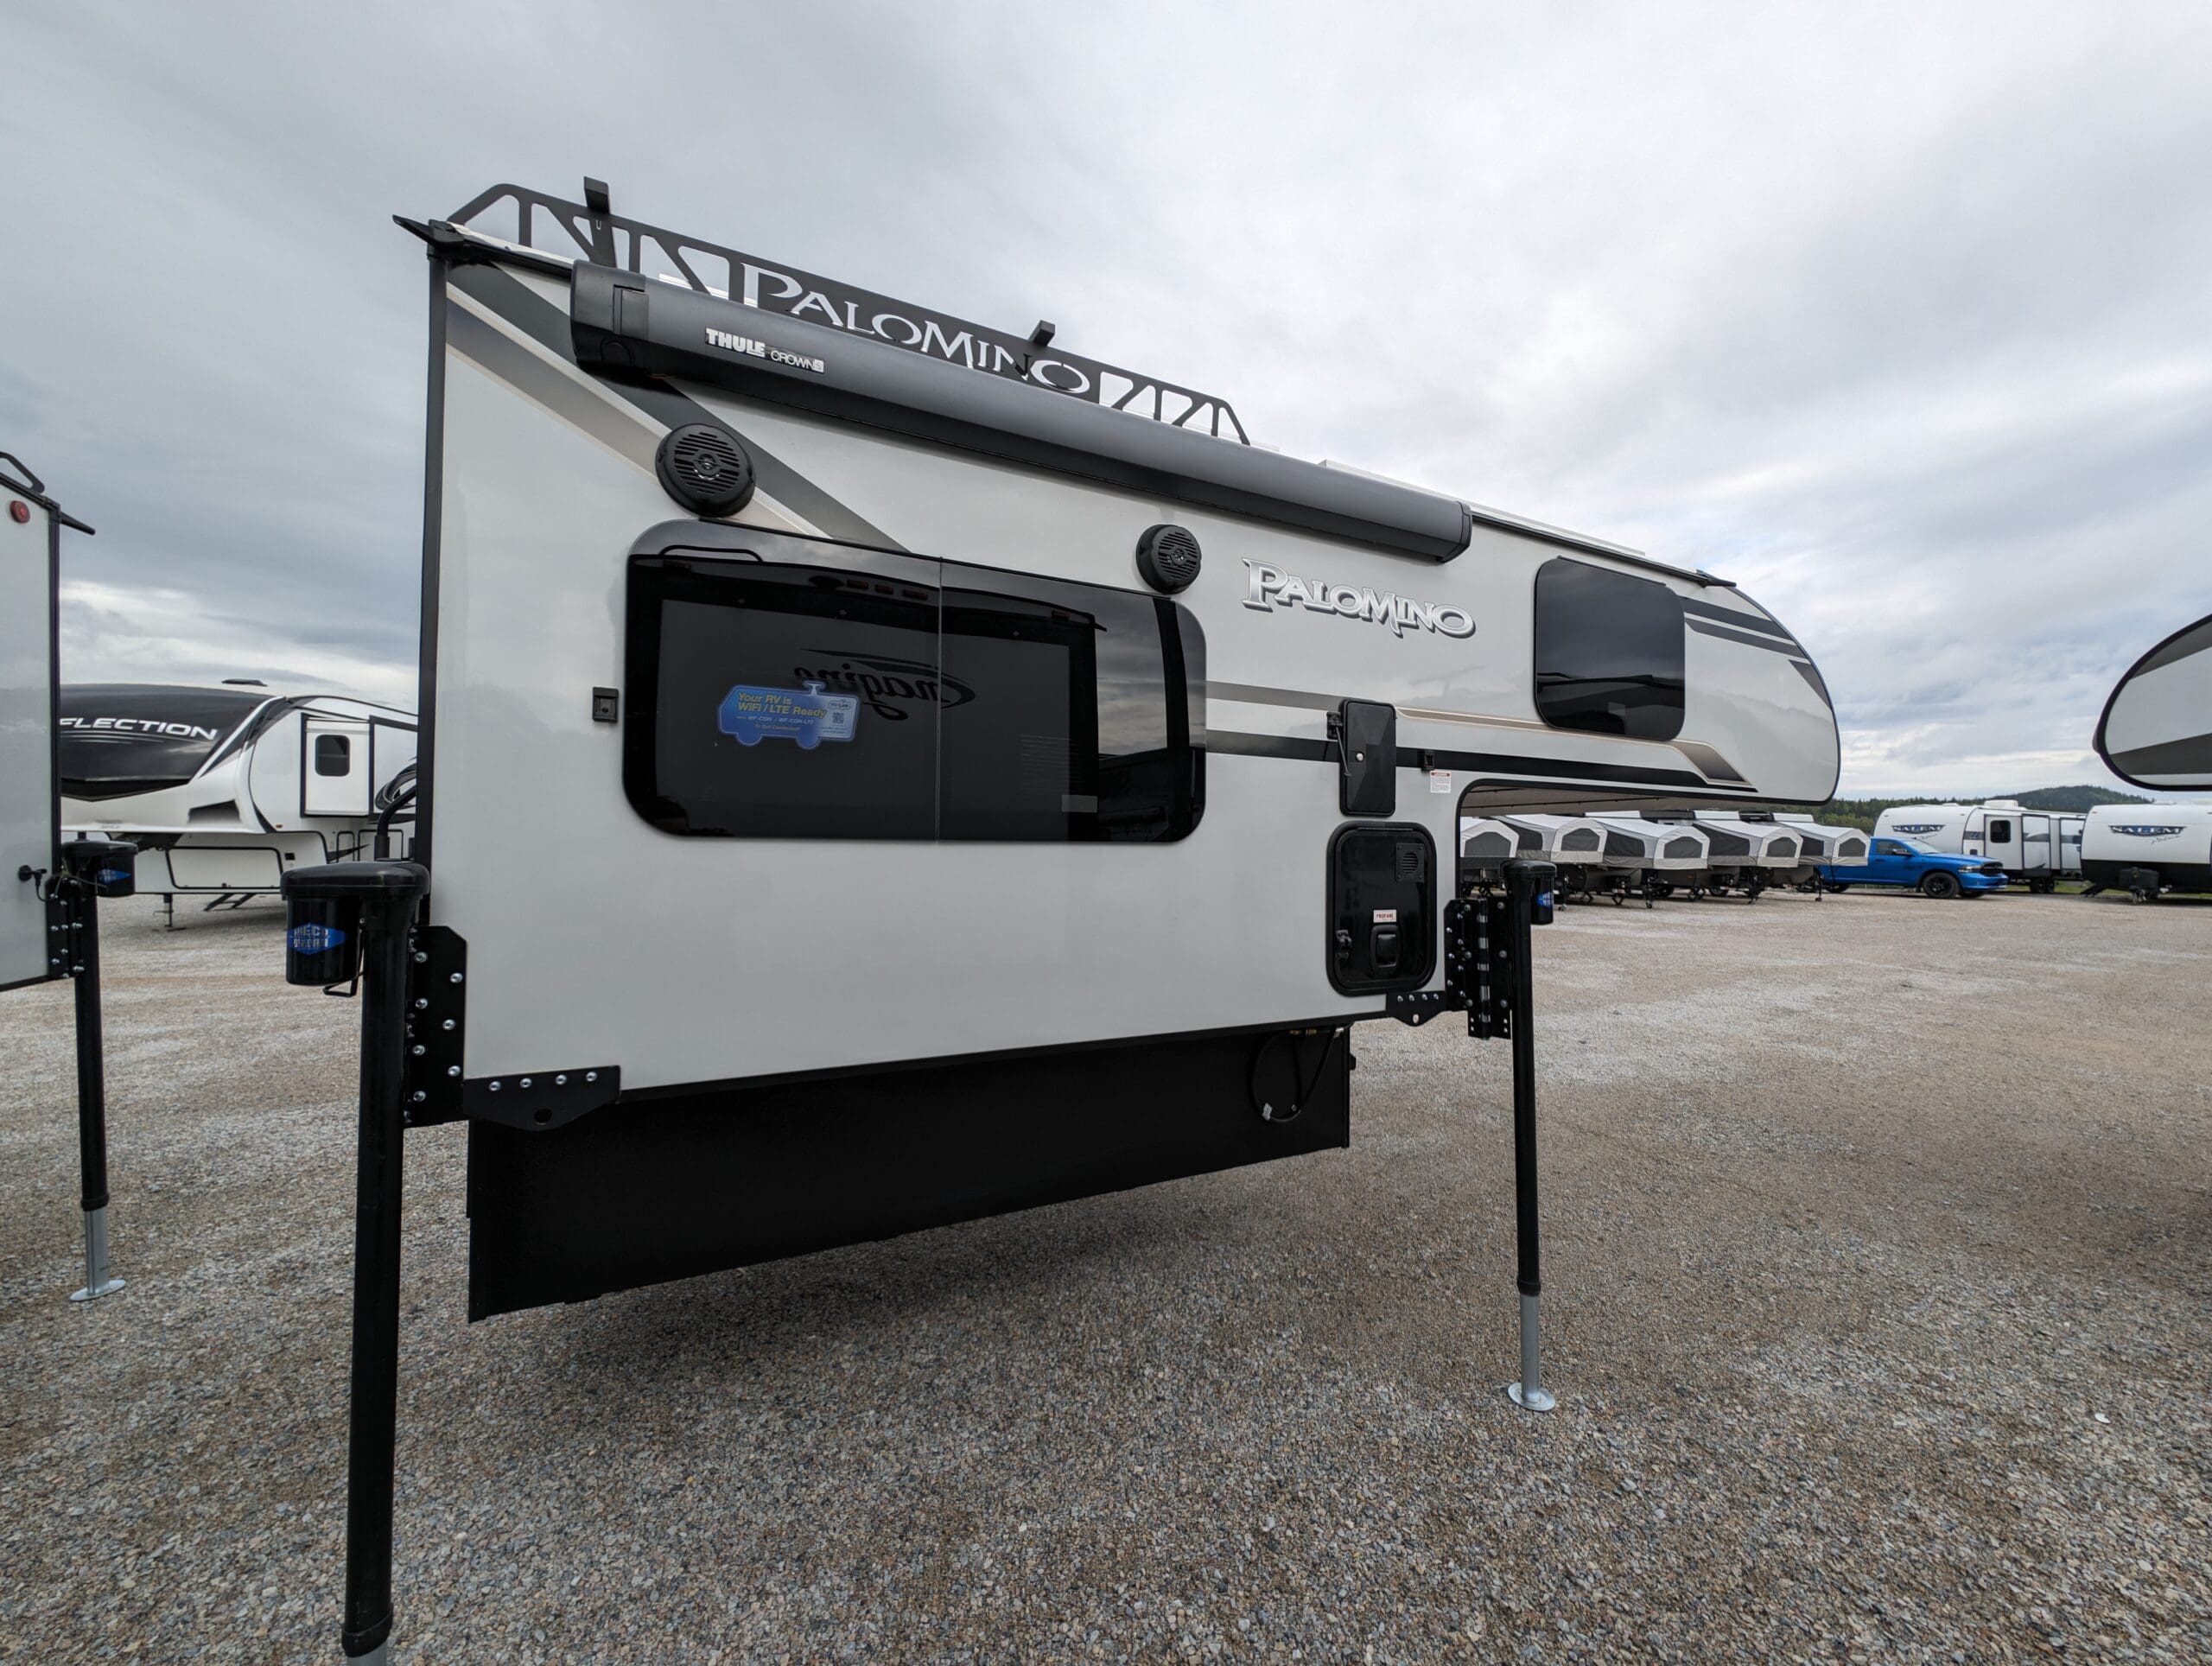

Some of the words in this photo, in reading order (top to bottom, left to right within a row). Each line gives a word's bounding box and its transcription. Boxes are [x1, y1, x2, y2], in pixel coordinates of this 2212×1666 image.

[705, 327, 766, 359] THULE
[770, 350, 815, 371] CROWN
[741, 262, 1090, 394] PALOMINO
[1242, 557, 1477, 639] PALOMINO
[738, 692, 763, 703] Your
[765, 694, 781, 703] RV
[782, 696, 792, 705] is
[769, 704, 790, 715] LTE
[792, 707, 827, 720] Ready
